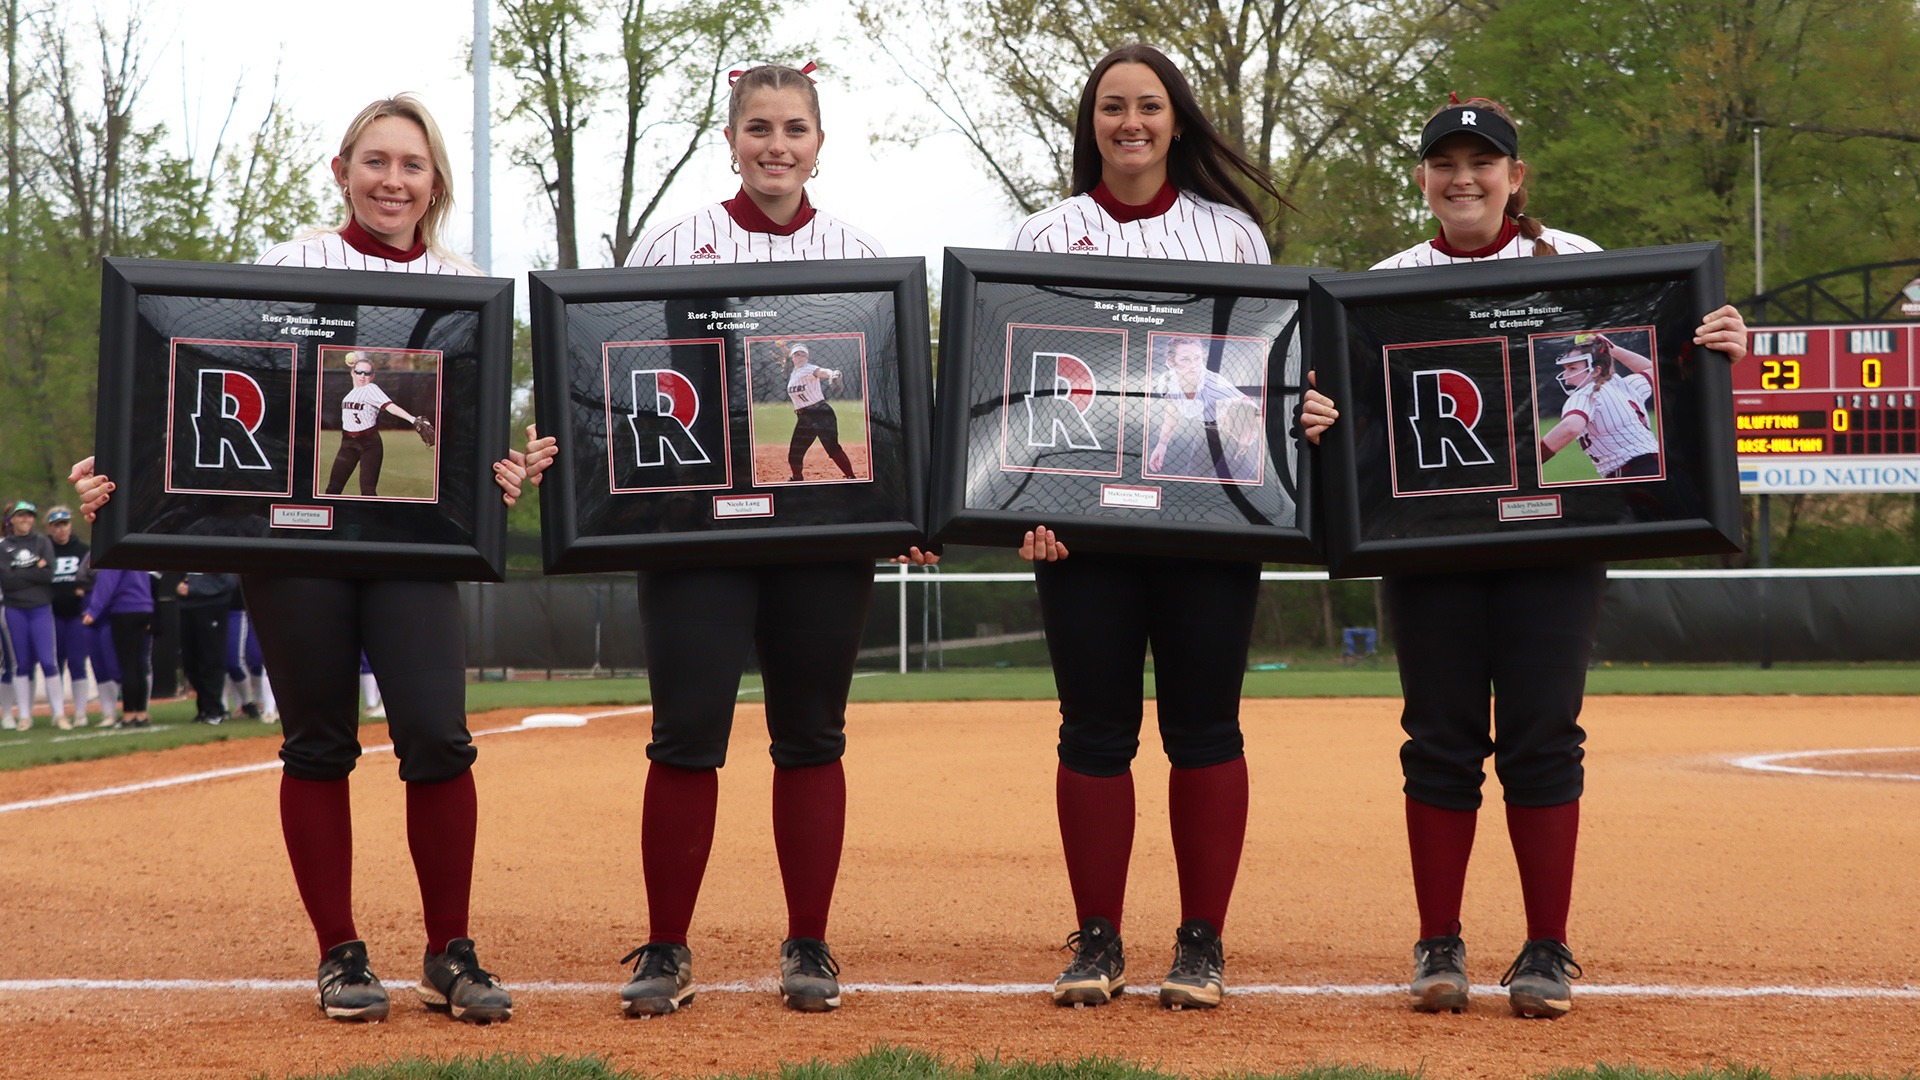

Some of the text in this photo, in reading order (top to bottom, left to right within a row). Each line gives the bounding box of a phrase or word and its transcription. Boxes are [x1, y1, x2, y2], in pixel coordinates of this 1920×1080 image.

[1461, 110, 1477, 126] R
[687, 309, 778, 320] Rose-Hulman Institute
[1094, 300, 1184, 314] Rose-Hulman Institute
[1469, 306, 1563, 319] Rose-Hulman Institute
[261, 313, 355, 327] Rose-Hulman Institute
[706, 321, 760, 330] of Technology
[1112, 313, 1165, 325] of Technology
[1489, 318, 1544, 329] of Technology
[280, 326, 335, 338] of Technology
[1754, 331, 1807, 356] AT BAT
[1850, 330, 1891, 354] BALL
[1761, 360, 1800, 390] 23
[1861, 358, 1881, 388] 0
[1024, 351, 1102, 450] R
[1836, 393, 1914, 408] 1 2 3 4 5
[190, 368, 273, 470] R
[627, 368, 712, 468] R
[1409, 368, 1495, 470] R
[1737, 409, 1848, 432] BLUFFTON 0
[1737, 437, 1823, 453] ROSE-HULMAN
[1764, 468, 1816, 486] OLD
[54, 556, 80, 575] B
